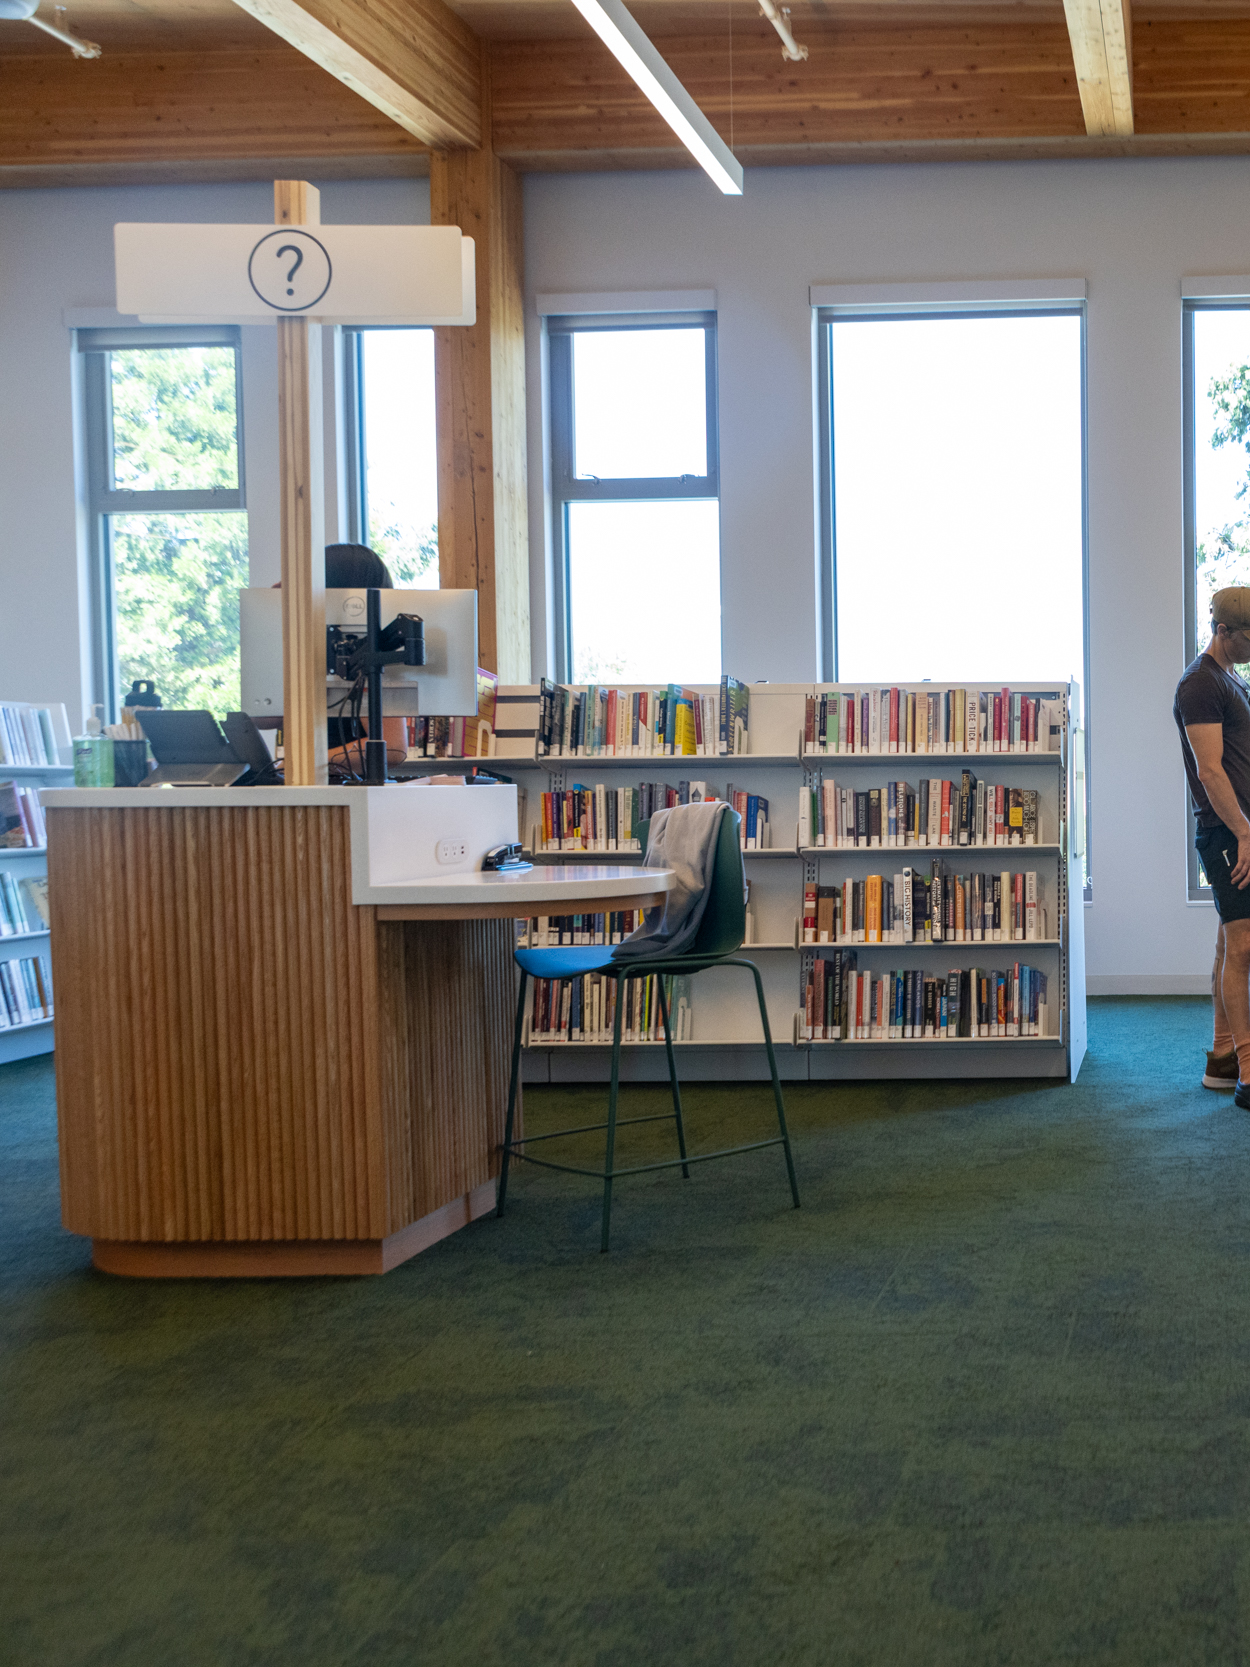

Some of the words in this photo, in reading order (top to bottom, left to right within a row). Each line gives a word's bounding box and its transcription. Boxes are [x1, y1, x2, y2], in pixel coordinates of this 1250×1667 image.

[968, 702, 976, 722] PRICE
[968, 726, 976, 742] TICK
[949, 977, 957, 996] HIGH
